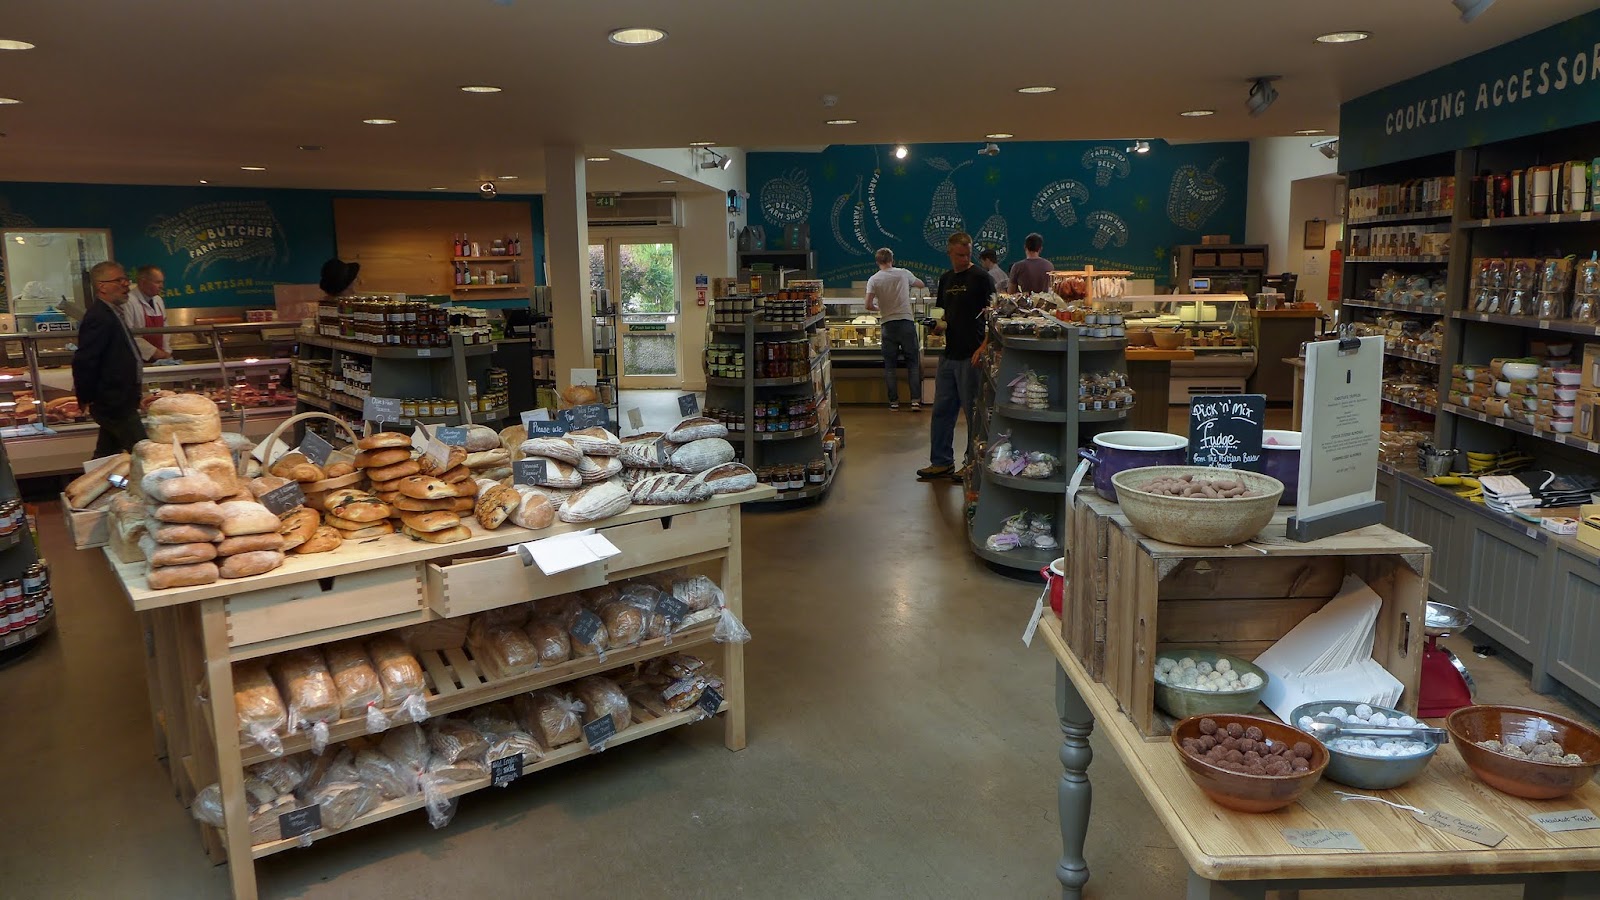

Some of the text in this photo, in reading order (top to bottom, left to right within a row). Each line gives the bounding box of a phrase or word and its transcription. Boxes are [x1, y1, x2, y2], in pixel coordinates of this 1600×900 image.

[1385, 90, 1465, 136] COOKING
[1090, 149, 1126, 162] FARM SHOP
[1097, 160, 1116, 170] DELI
[868, 173, 880, 194] FARM
[1037, 182, 1076, 207] FARM SHOP
[776, 202, 796, 212] DELI
[868, 196, 879, 215] SHOP
[1050, 196, 1070, 210] DELI
[765, 204, 803, 220] FARM SHOP
[930, 215, 946, 224] FARM
[934, 220, 956, 228] DELI
[1114, 219, 1126, 233] SHOP
[206, 225, 272, 240] BUTCHER
[854, 228, 866, 244] SHOP
[982, 230, 1005, 240] DELI
[1099, 224, 1116, 236] DELI
[190, 238, 245, 259] FARM SHOP
[159, 288, 182, 298] CAL
[185, 284, 196, 294] &
[199, 278, 254, 292] ARTISAN
[1192, 402, 1218, 421] Pick
[1232, 403, 1254, 418] Mix
[532, 422, 550, 434] Please
